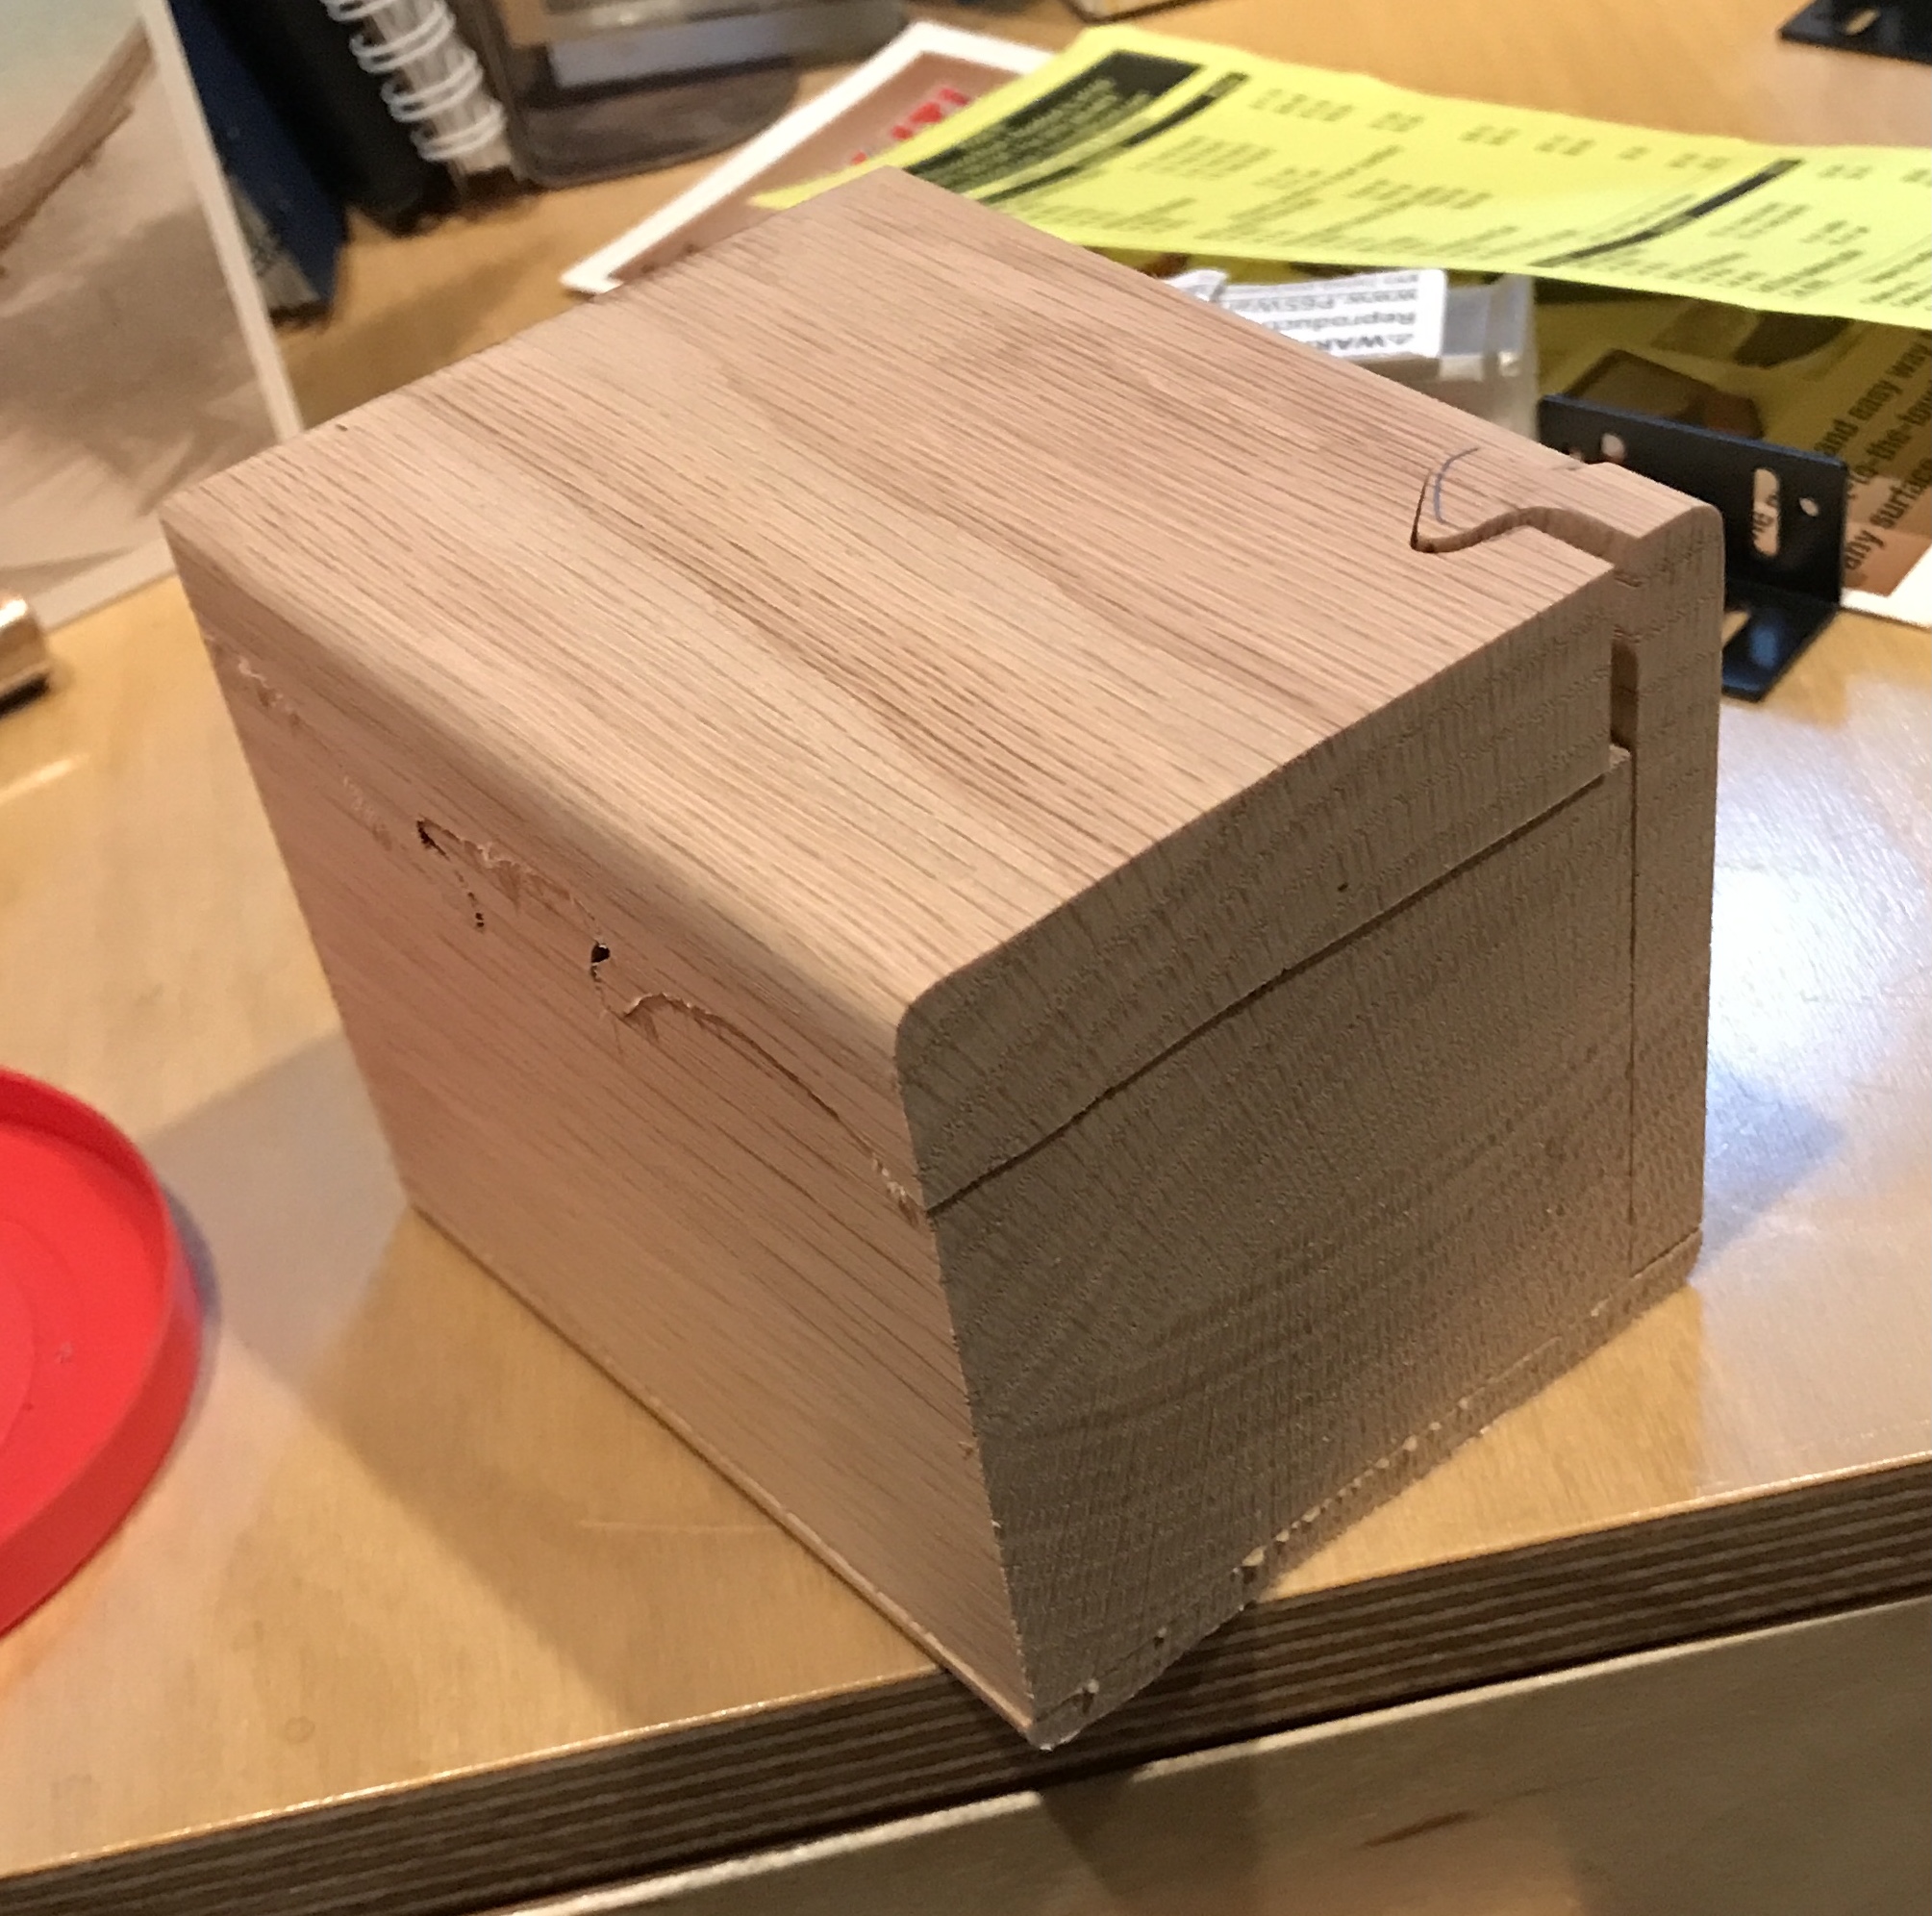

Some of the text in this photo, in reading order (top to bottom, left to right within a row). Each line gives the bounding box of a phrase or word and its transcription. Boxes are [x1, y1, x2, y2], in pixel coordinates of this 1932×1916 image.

[1847, 379, 1903, 421] easy
[1886, 341, 1932, 379] way
[1845, 529, 1885, 570] any
